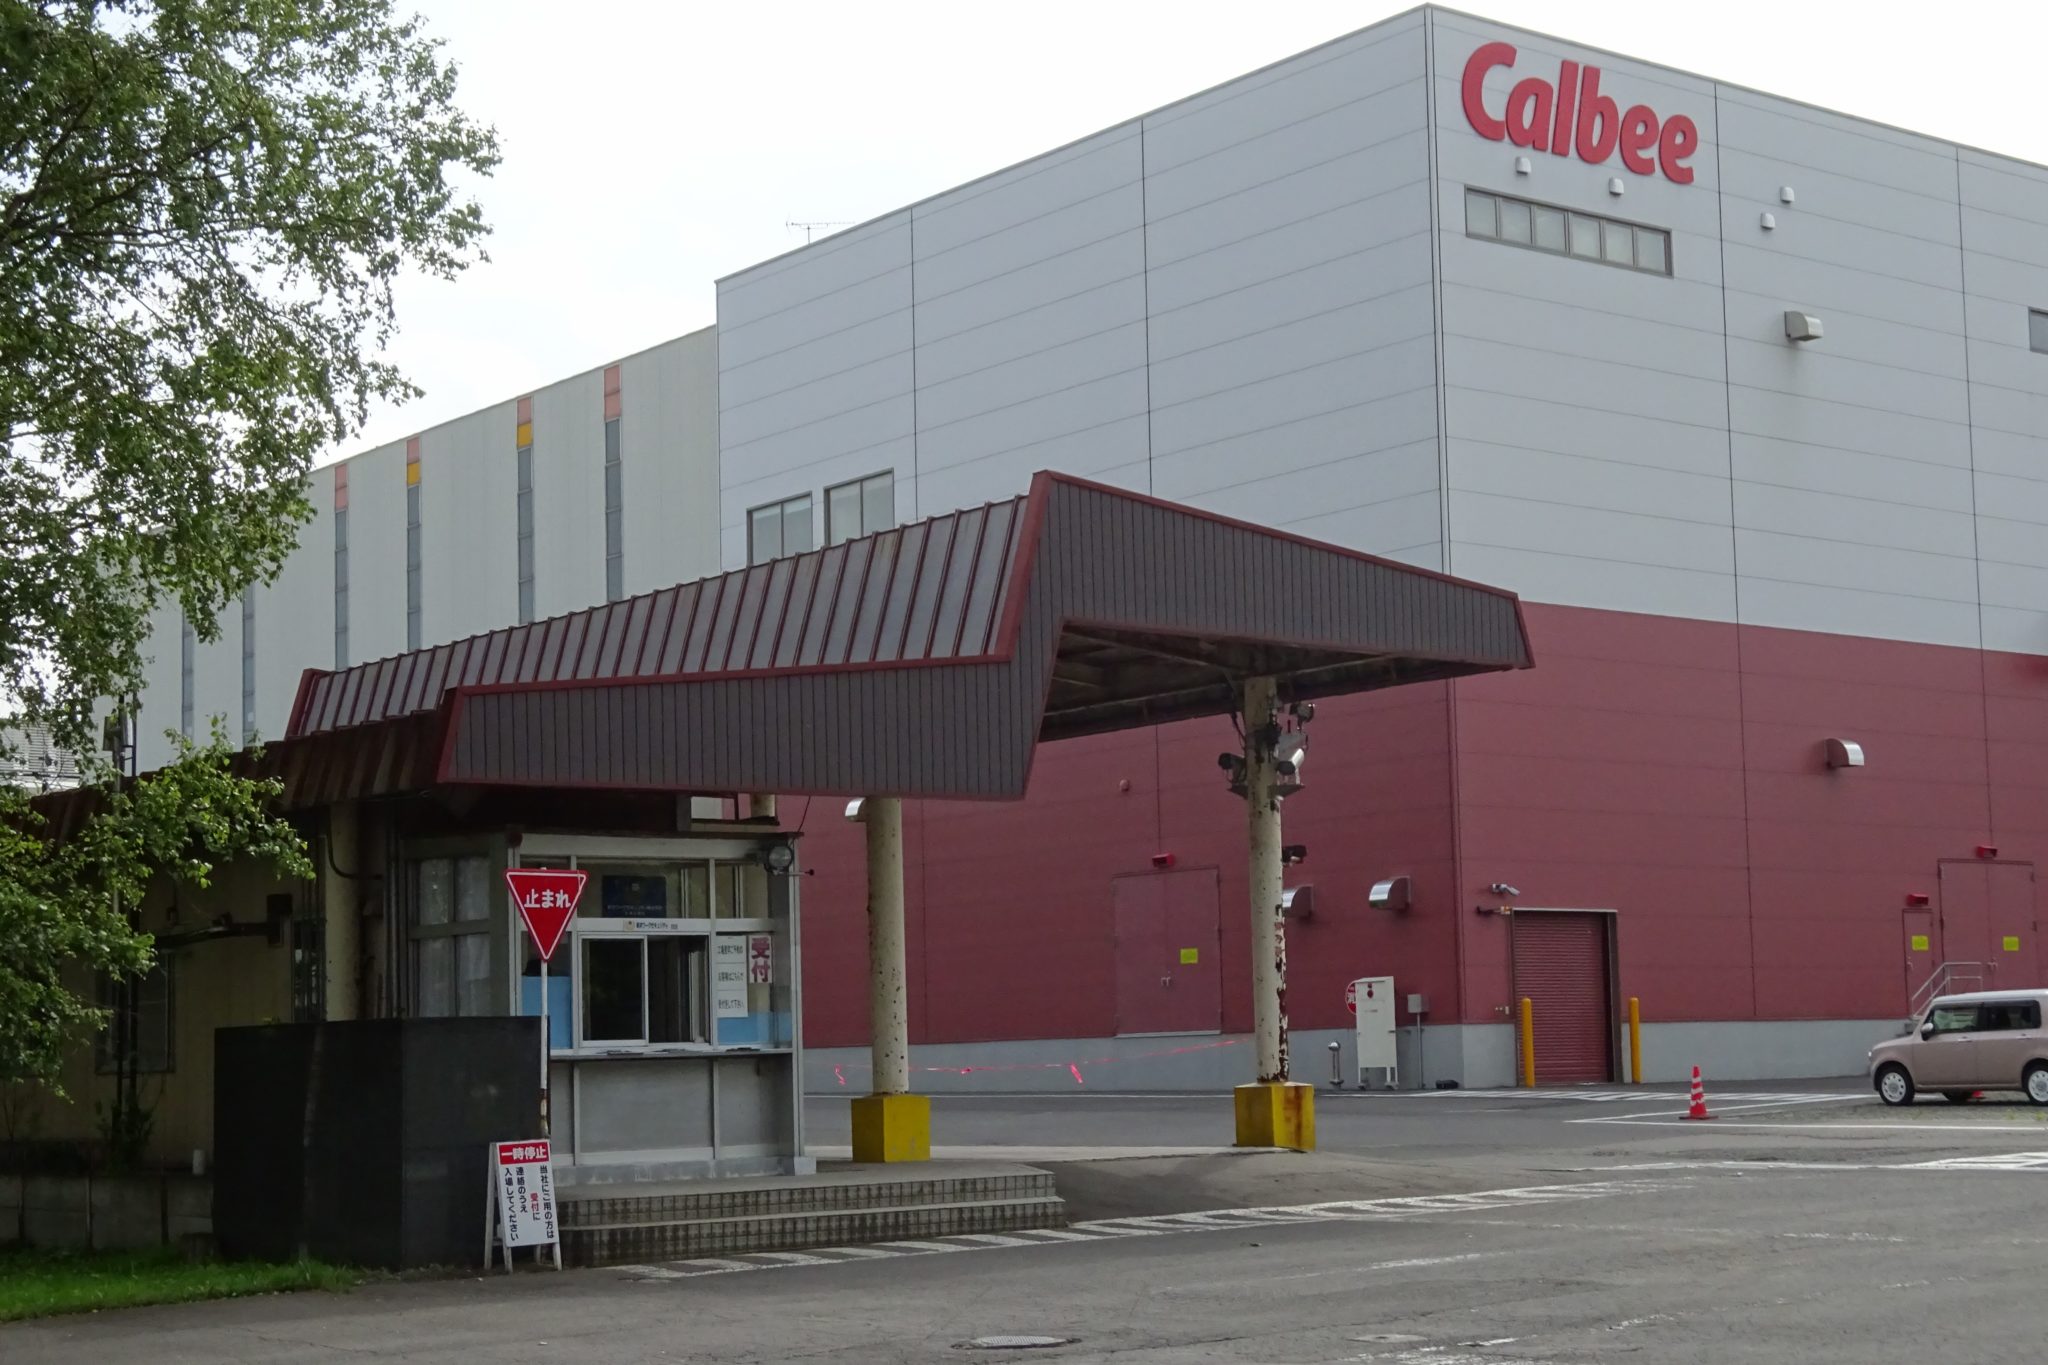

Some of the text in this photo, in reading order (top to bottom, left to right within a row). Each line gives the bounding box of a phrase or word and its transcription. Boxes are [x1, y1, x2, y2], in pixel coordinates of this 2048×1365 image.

[1461, 41, 1698, 184] Calbee
[524, 888, 571, 909] 止まれ
[751, 936, 771, 983] 受付
[501, 1145, 547, 1160] 一時停止
[505, 1167, 519, 1241] 入場してください
[516, 1166, 528, 1213] 連絡のうえ
[530, 1192, 541, 1221] 受付に
[540, 1165, 554, 1239] 当社にご用の方は
